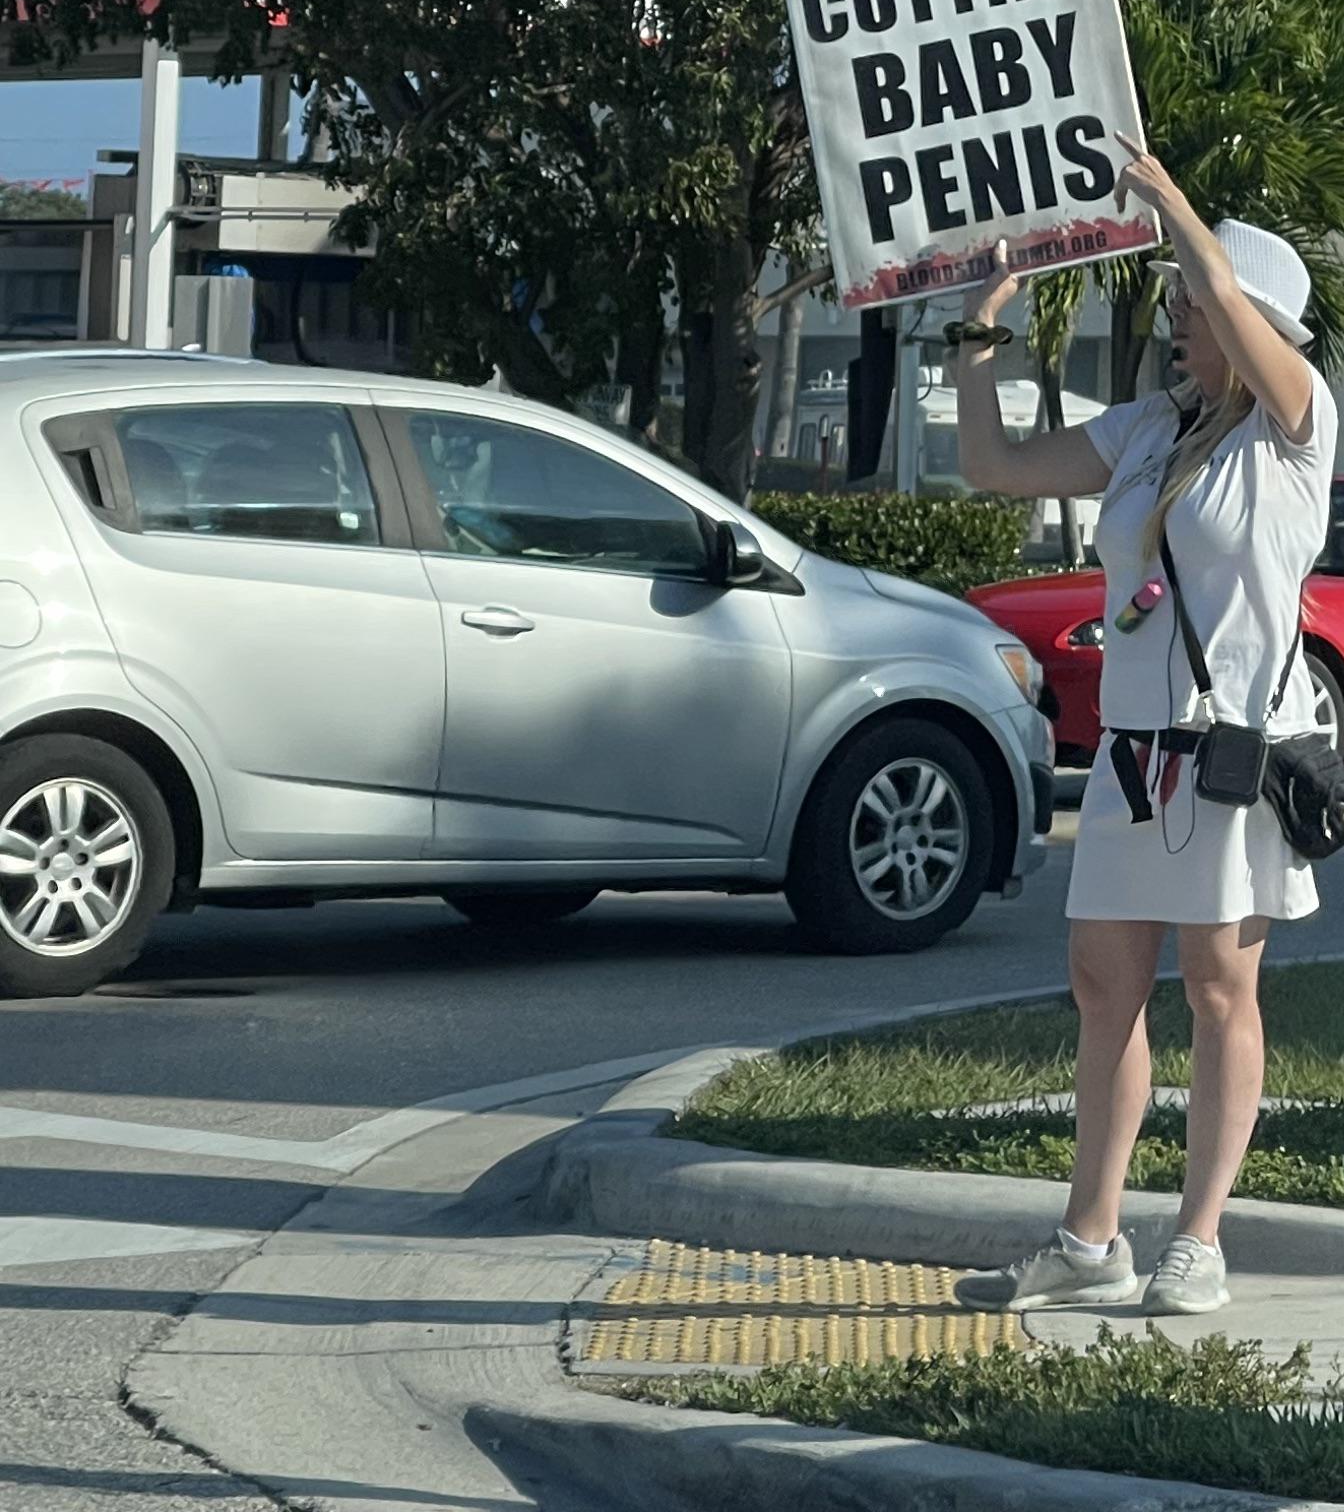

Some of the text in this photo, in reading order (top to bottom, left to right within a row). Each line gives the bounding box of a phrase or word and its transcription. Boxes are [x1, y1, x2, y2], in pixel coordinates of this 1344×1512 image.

[851, 11, 1078, 139] BABY
[858, 115, 1116, 244] PENIS
[895, 230, 1108, 291] BLOODSTAIEDMEN.ORG
